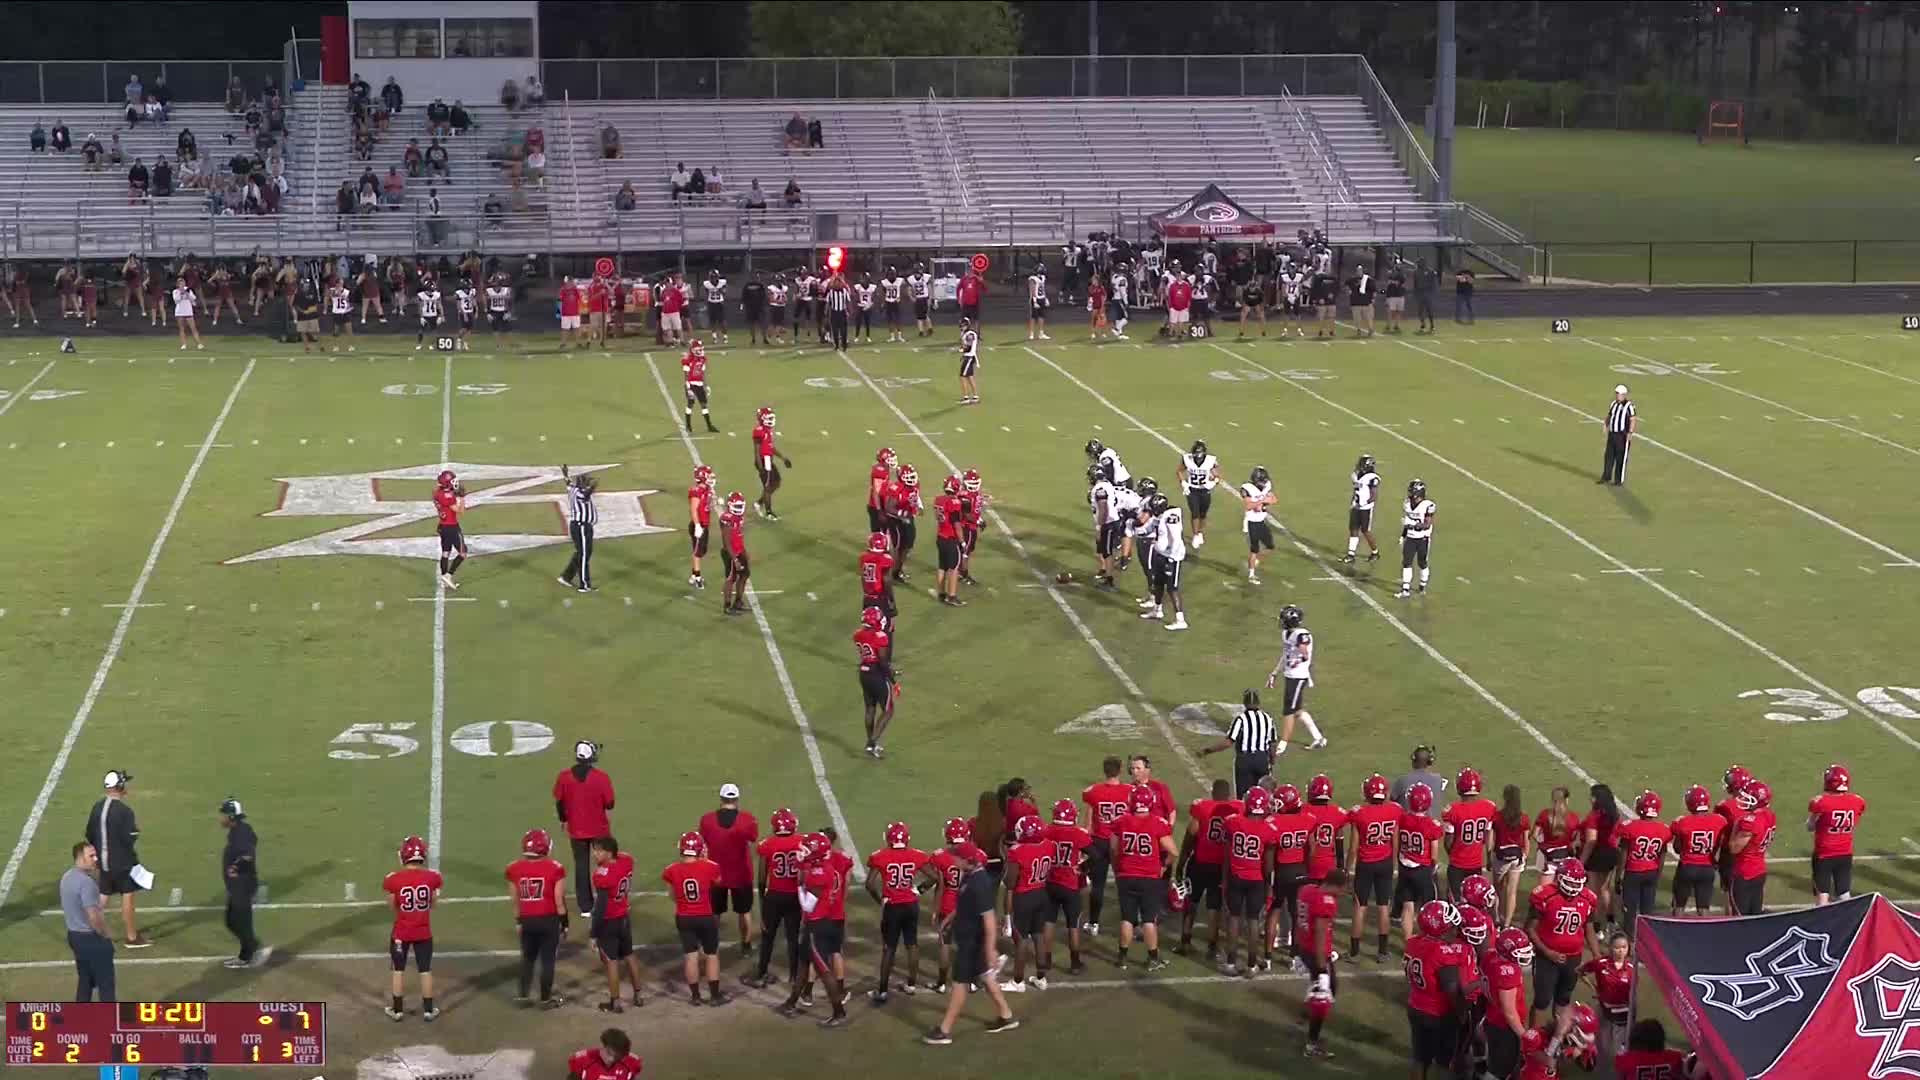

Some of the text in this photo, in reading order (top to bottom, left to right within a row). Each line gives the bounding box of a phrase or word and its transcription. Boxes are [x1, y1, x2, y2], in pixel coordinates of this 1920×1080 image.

[1200, 225, 1242, 234] PANTHERS
[1191, 326, 1205, 337] 30
[1555, 320, 1570, 332] 20
[1904, 317, 1919, 329] 10
[438, 338, 453, 350] 50
[1190, 473, 1207, 486] 22
[328, 720, 555, 759] 50
[1098, 801, 1128, 824] 56
[1828, 809, 1855, 834] 71
[1367, 820, 1397, 846] 25
[1461, 816, 1488, 846] 88
[1690, 830, 1715, 854] 51
[1122, 832, 1153, 856] 76
[1232, 831, 1261, 860] 82
[1632, 835, 1663, 861] 33
[887, 862, 915, 889] 35
[1027, 855, 1051, 885] 10
[400, 884, 431, 912] 39
[519, 877, 545, 901] 17
[683, 878, 700, 902] 8
[1553, 910, 1582, 935] 78
